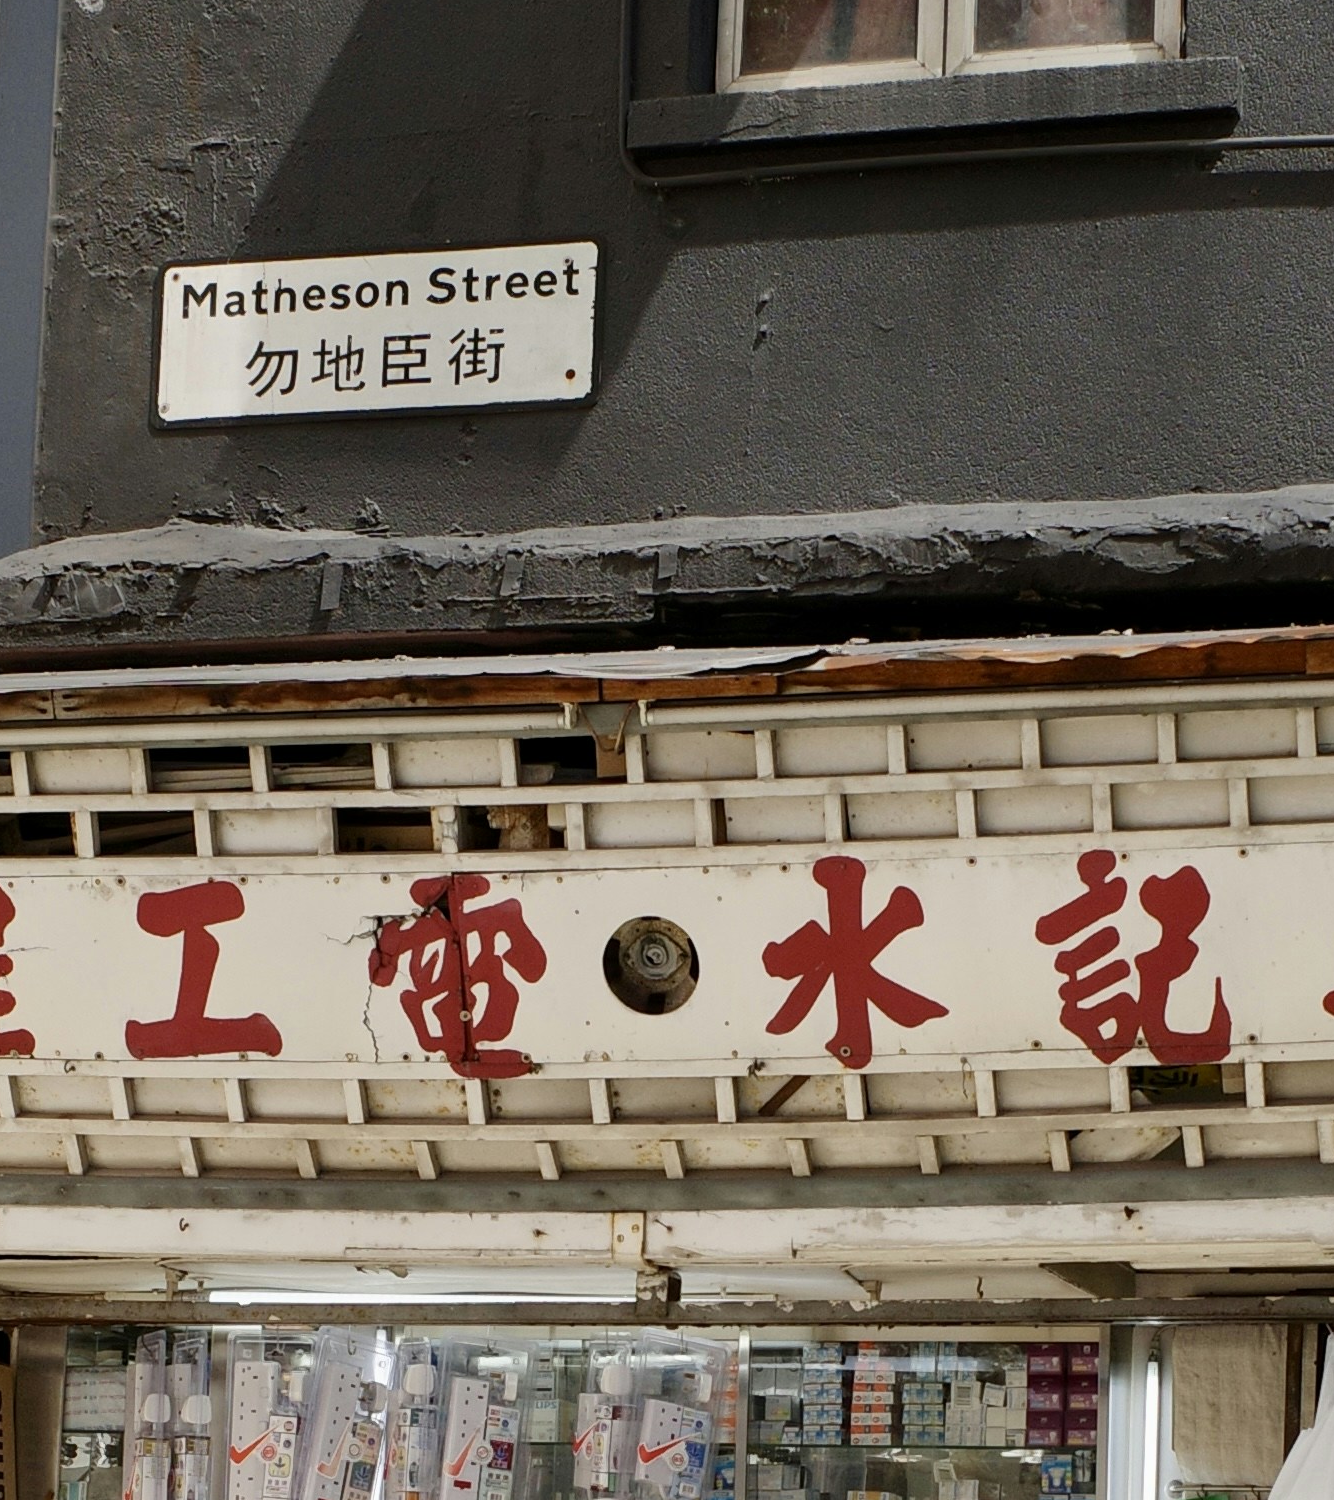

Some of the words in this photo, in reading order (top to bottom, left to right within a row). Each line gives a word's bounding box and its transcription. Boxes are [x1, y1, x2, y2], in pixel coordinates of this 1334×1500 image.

[181, 278, 409, 319] Matheson
[425, 257, 580, 305] Street
[245, 327, 506, 397] 勿地臣街
